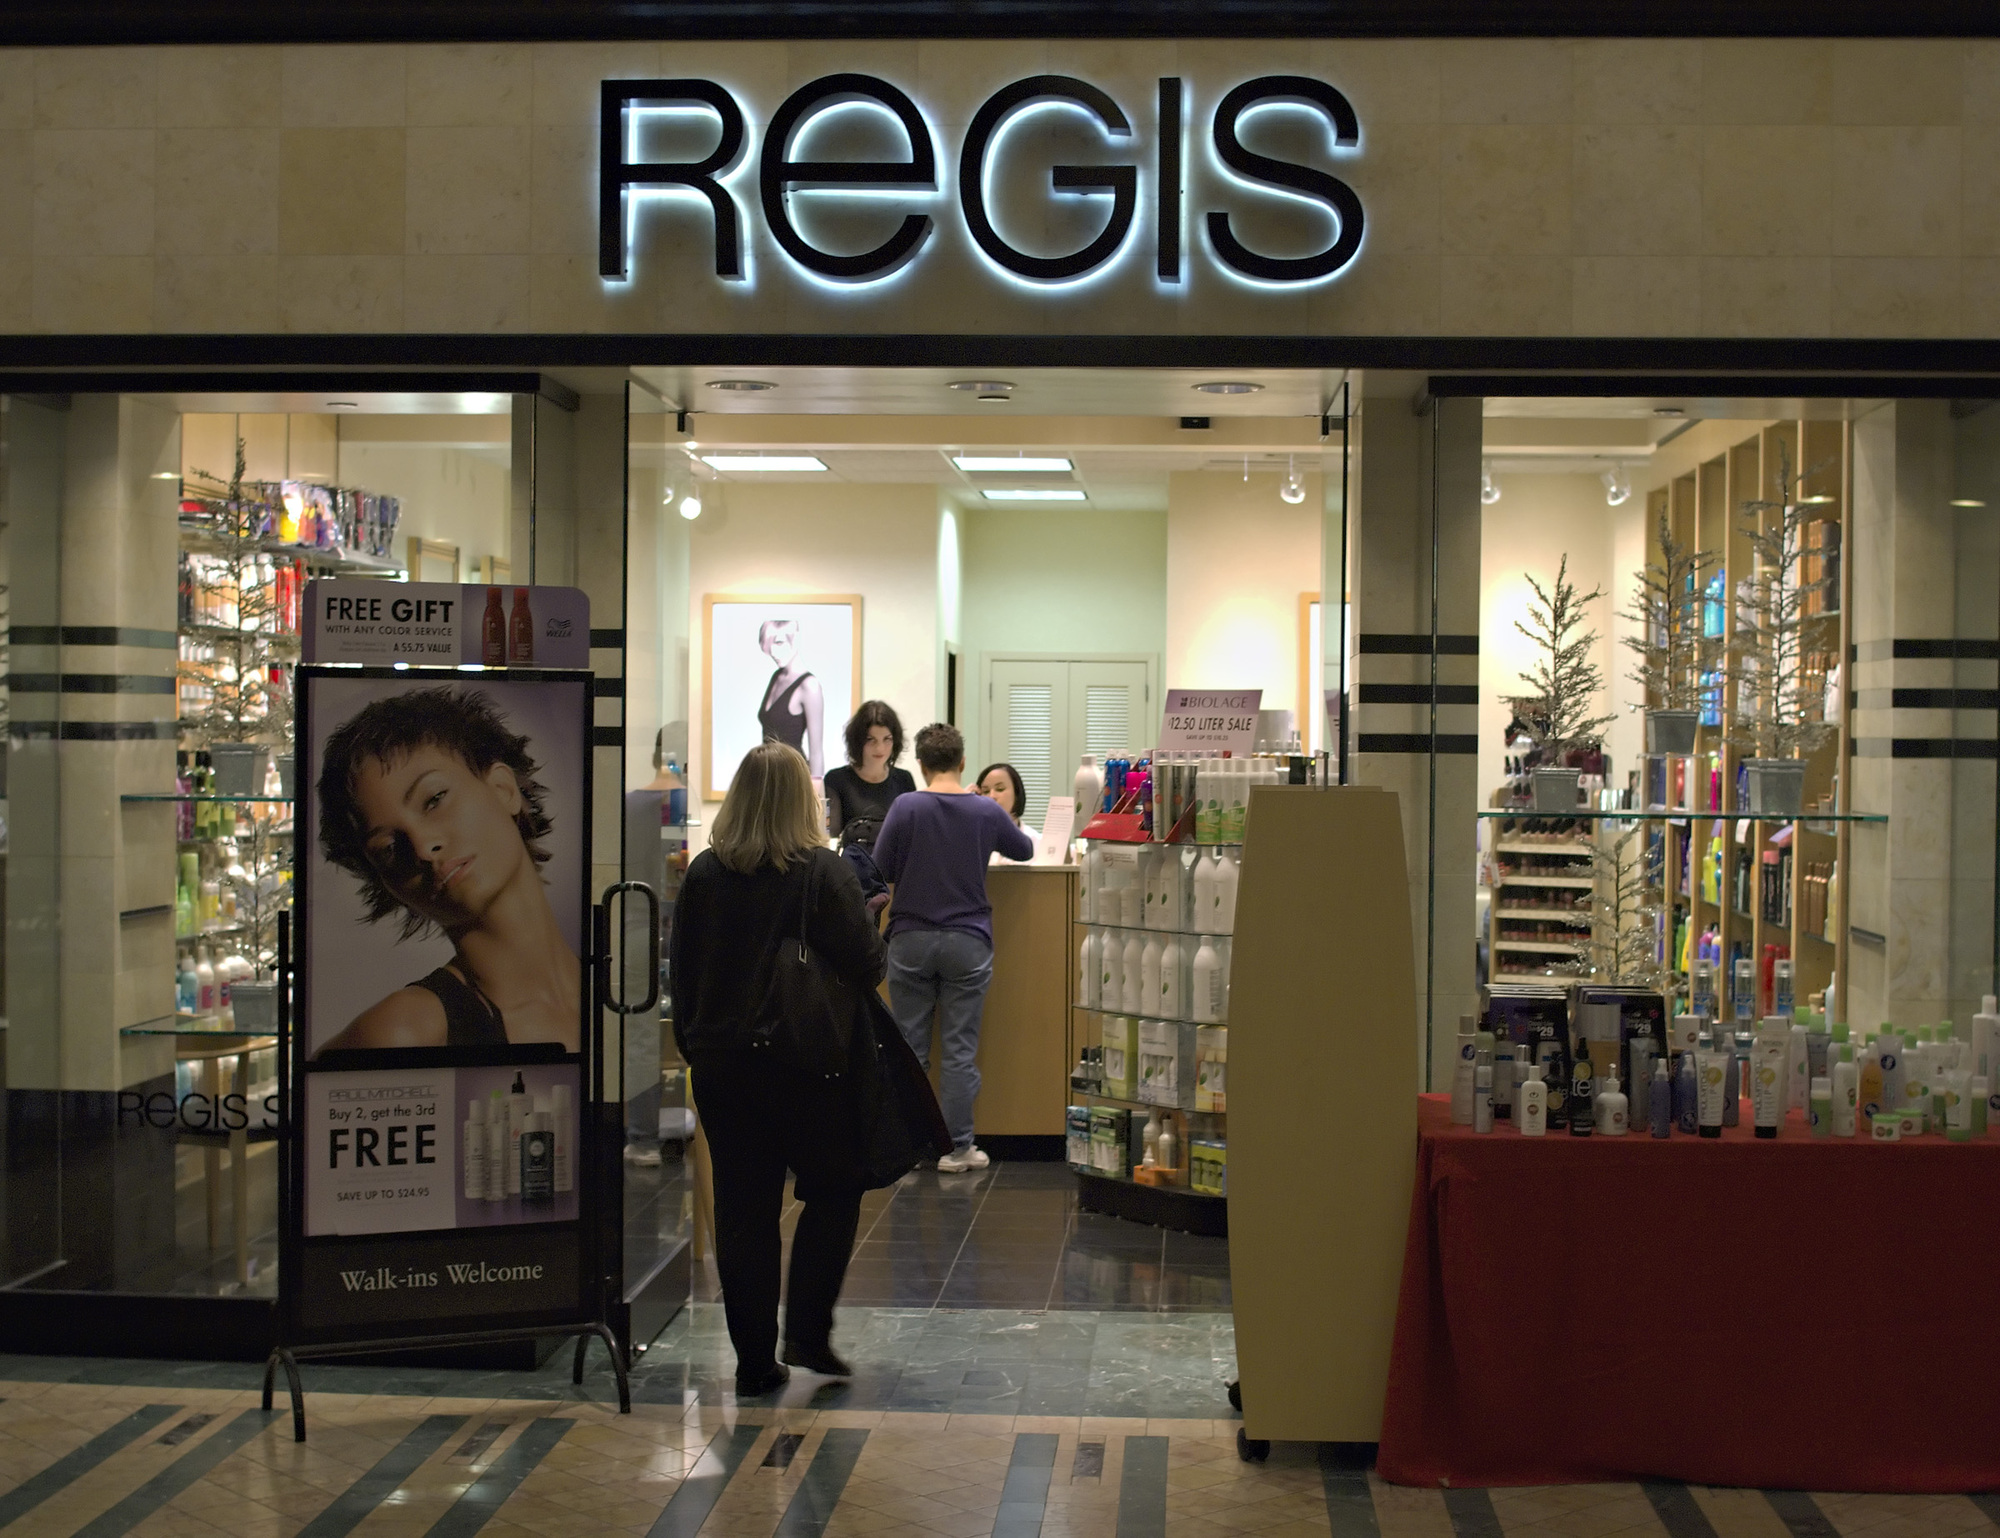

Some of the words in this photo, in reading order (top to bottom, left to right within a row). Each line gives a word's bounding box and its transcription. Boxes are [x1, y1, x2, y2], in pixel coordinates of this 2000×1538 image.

[326, 597, 381, 621] FREE
[391, 599, 454, 623] GIFT
[325, 625, 350, 634] WITH
[354, 626, 375, 635] ANY
[379, 626, 411, 635] COLOR
[415, 627, 452, 636] SERVICE
[393, 643, 399, 652] A
[402, 643, 424, 653] $5.75
[427, 643, 452, 653] VALUE
[1189, 697, 1247, 708] BIOLAGE
[1198, 718, 1225, 731] LITER
[1227, 718, 1252, 731] SALE
[329, 1089, 365, 1100] PAUL
[368, 1087, 437, 1098] MITCHELL
[329, 1108, 351, 1122] Buy
[356, 1107, 367, 1120] 2,
[371, 1107, 390, 1121] get
[393, 1104, 411, 1117] the
[416, 1103, 436, 1116] 3rd
[329, 1124, 437, 1169] FREE
[337, 1191, 362, 1202] SAVE
[365, 1191, 378, 1200] UP
[381, 1189, 394, 1199] TO
[398, 1187, 430, 1198] $24.95
[340, 1266, 438, 1292] Walk-ins
[446, 1261, 544, 1285] Welcome
